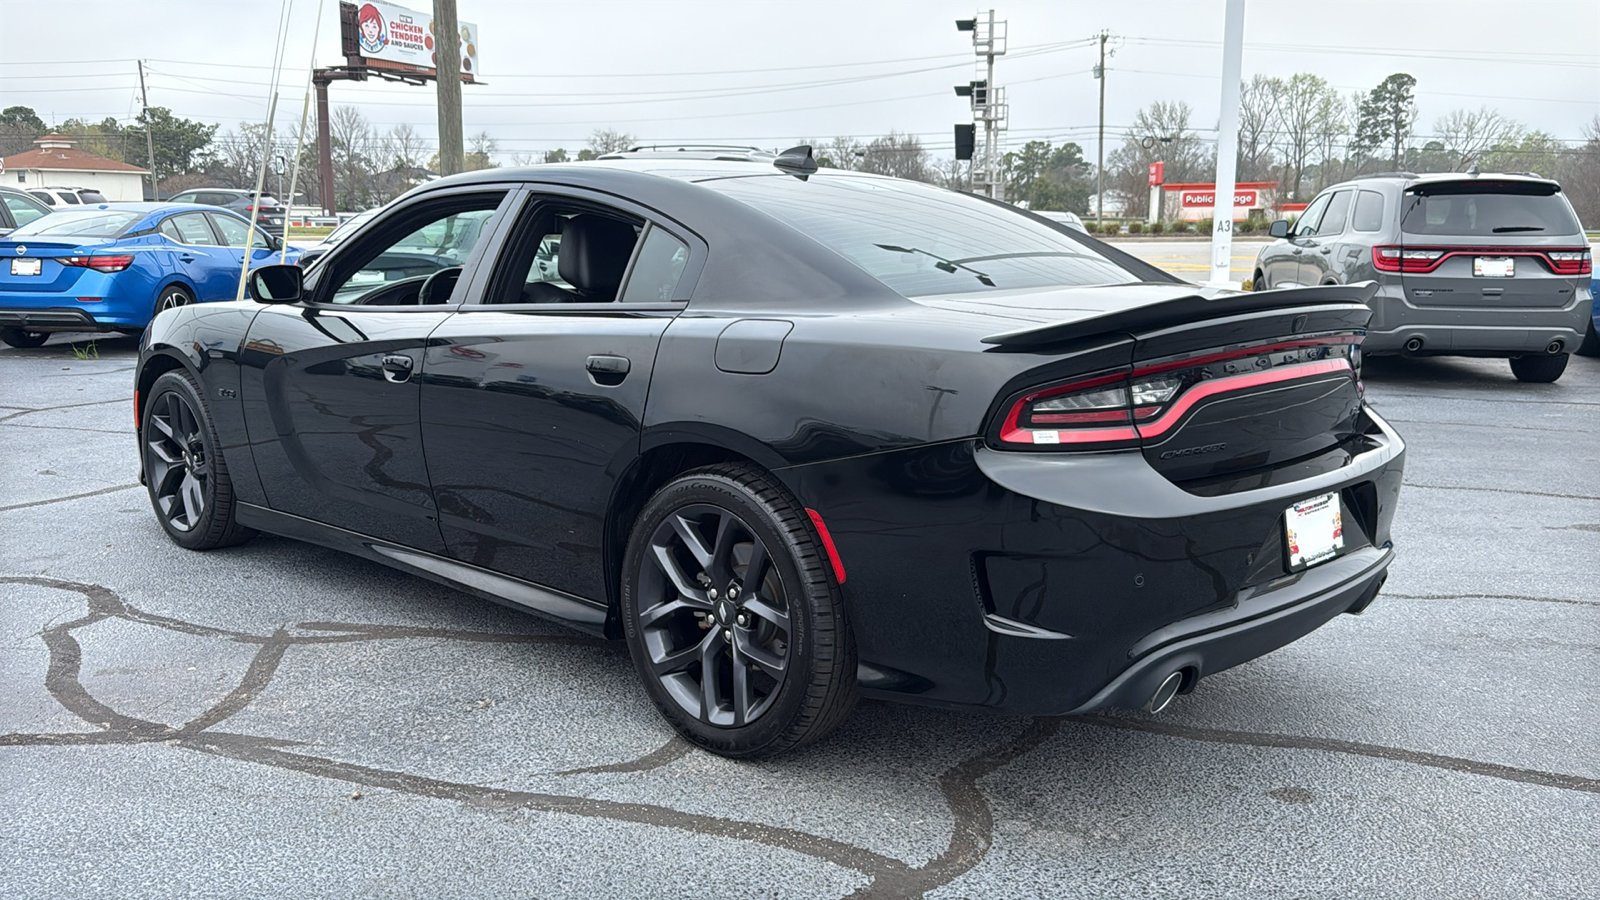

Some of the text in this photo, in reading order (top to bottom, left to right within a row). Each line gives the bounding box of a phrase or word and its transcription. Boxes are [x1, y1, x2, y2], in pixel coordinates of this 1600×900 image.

[390, 21, 423, 34] CHICKEN
[390, 30, 423, 44] TENDERS
[403, 42, 424, 51] SAUCES
[1186, 194, 1213, 203] Public
[1217, 220, 1231, 233] A3
